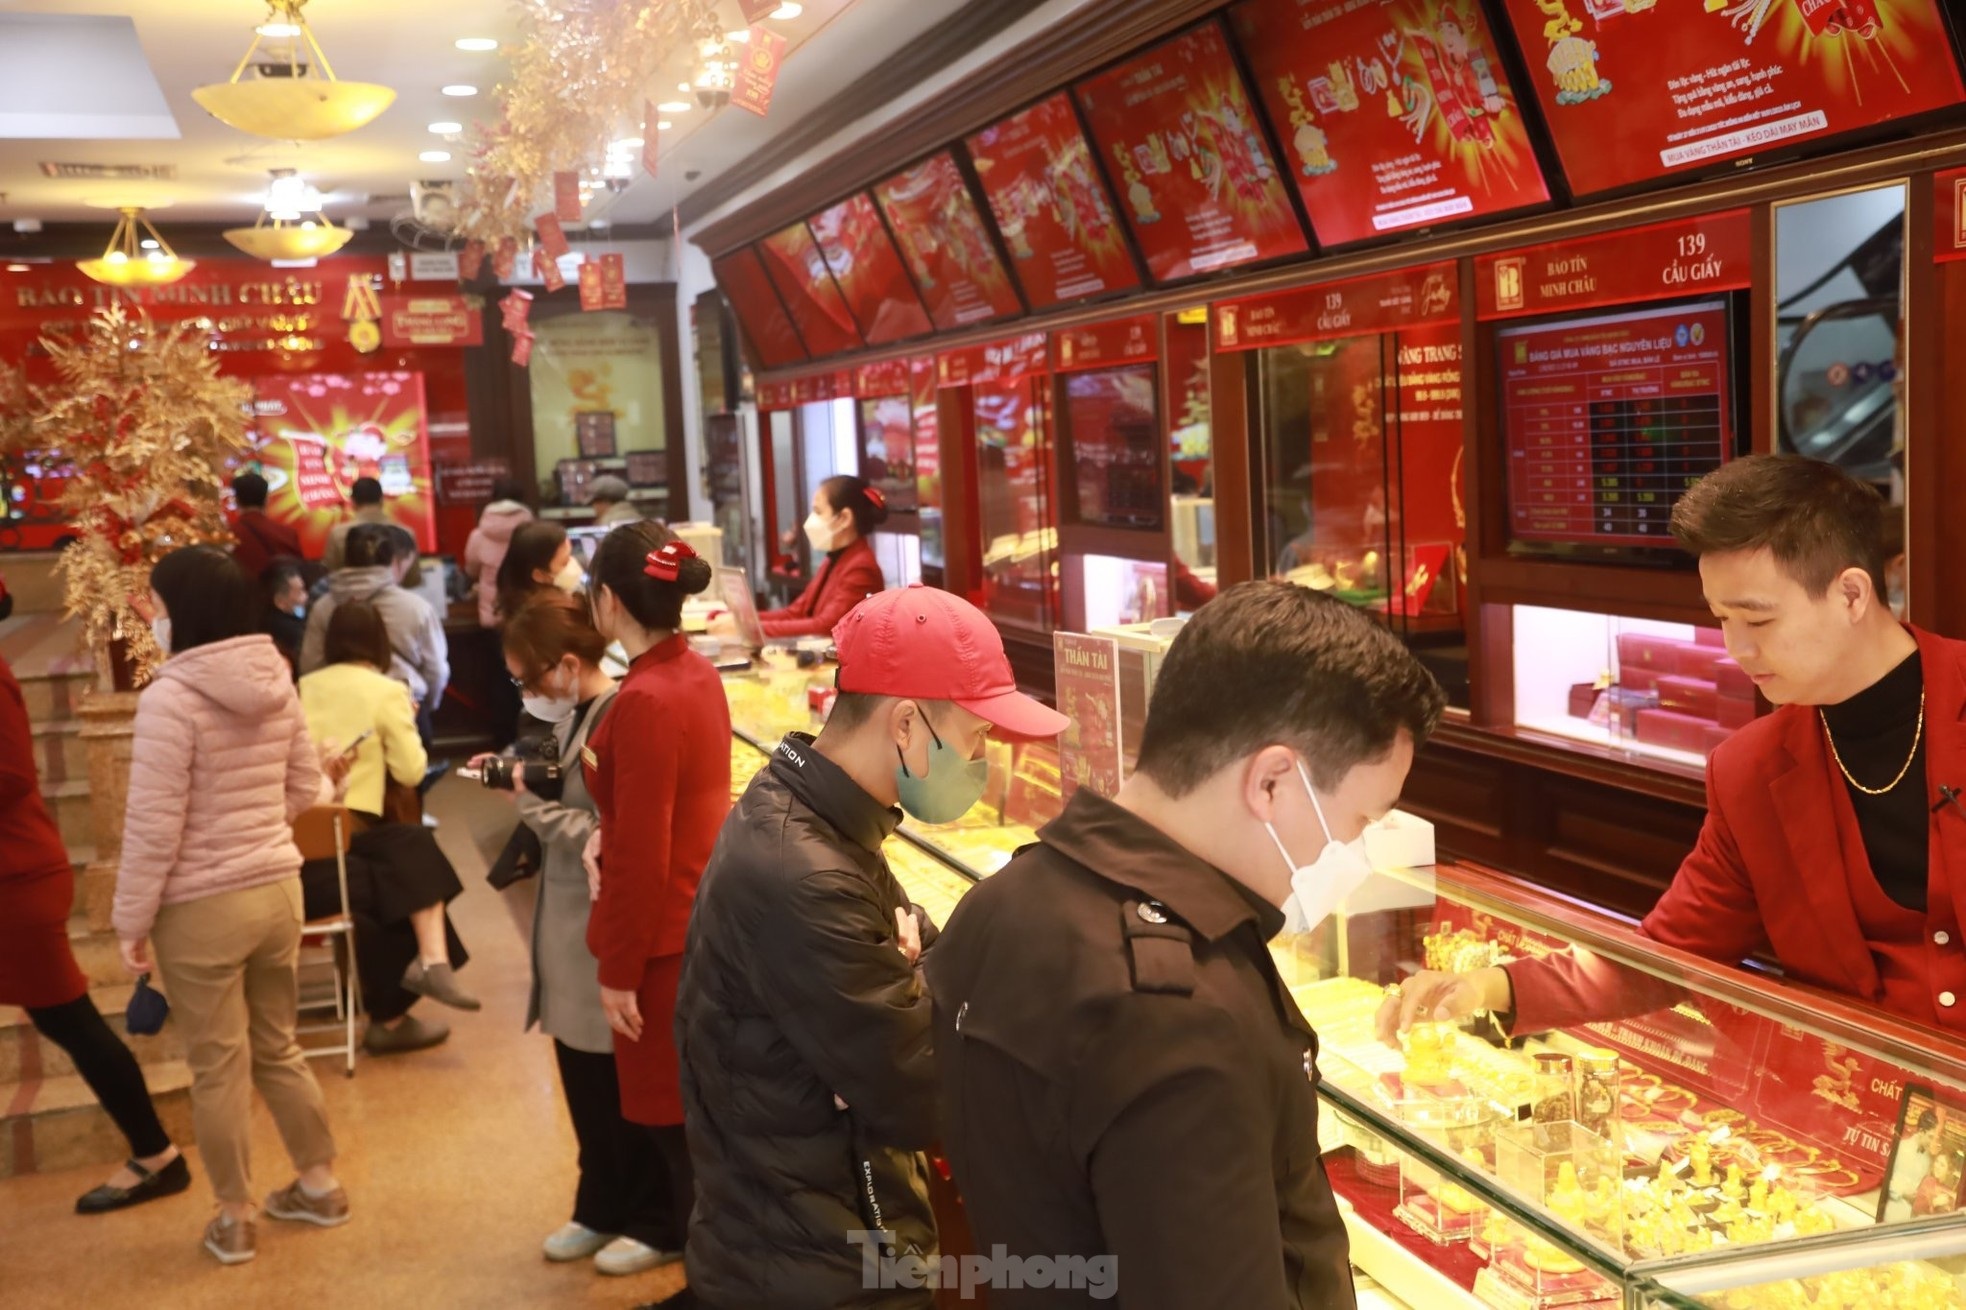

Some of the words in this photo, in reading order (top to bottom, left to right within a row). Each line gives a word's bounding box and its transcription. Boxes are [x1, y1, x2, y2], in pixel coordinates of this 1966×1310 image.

[1667, 151, 1685, 163] MUA
[1685, 147, 1706, 160] VÀNG
[1728, 136, 1741, 150] TÀI
[1746, 131, 1763, 145] KÉO
[1764, 126, 1779, 140] DÀI
[1779, 122, 1797, 136] MAY
[1799, 116, 1820, 131] MẮN
[1678, 233, 1706, 257] 139
[1569, 255, 1588, 274] TÍN
[1662, 259, 1688, 285] CẦU
[1691, 253, 1722, 281] GIẤY
[152, 283, 232, 306] MINH
[1540, 282, 1567, 298] MINH
[1568, 275, 1596, 294] CHÂU
[1620, 338, 1652, 353] NGUYÊN
[1653, 336, 1672, 352] LIỆU
[1091, 650, 1107, 669] TÀI
[1871, 1078, 1903, 1101] CHẤT
[1842, 1126, 1860, 1146] TỰ
[1861, 1132, 1881, 1153] TIN
